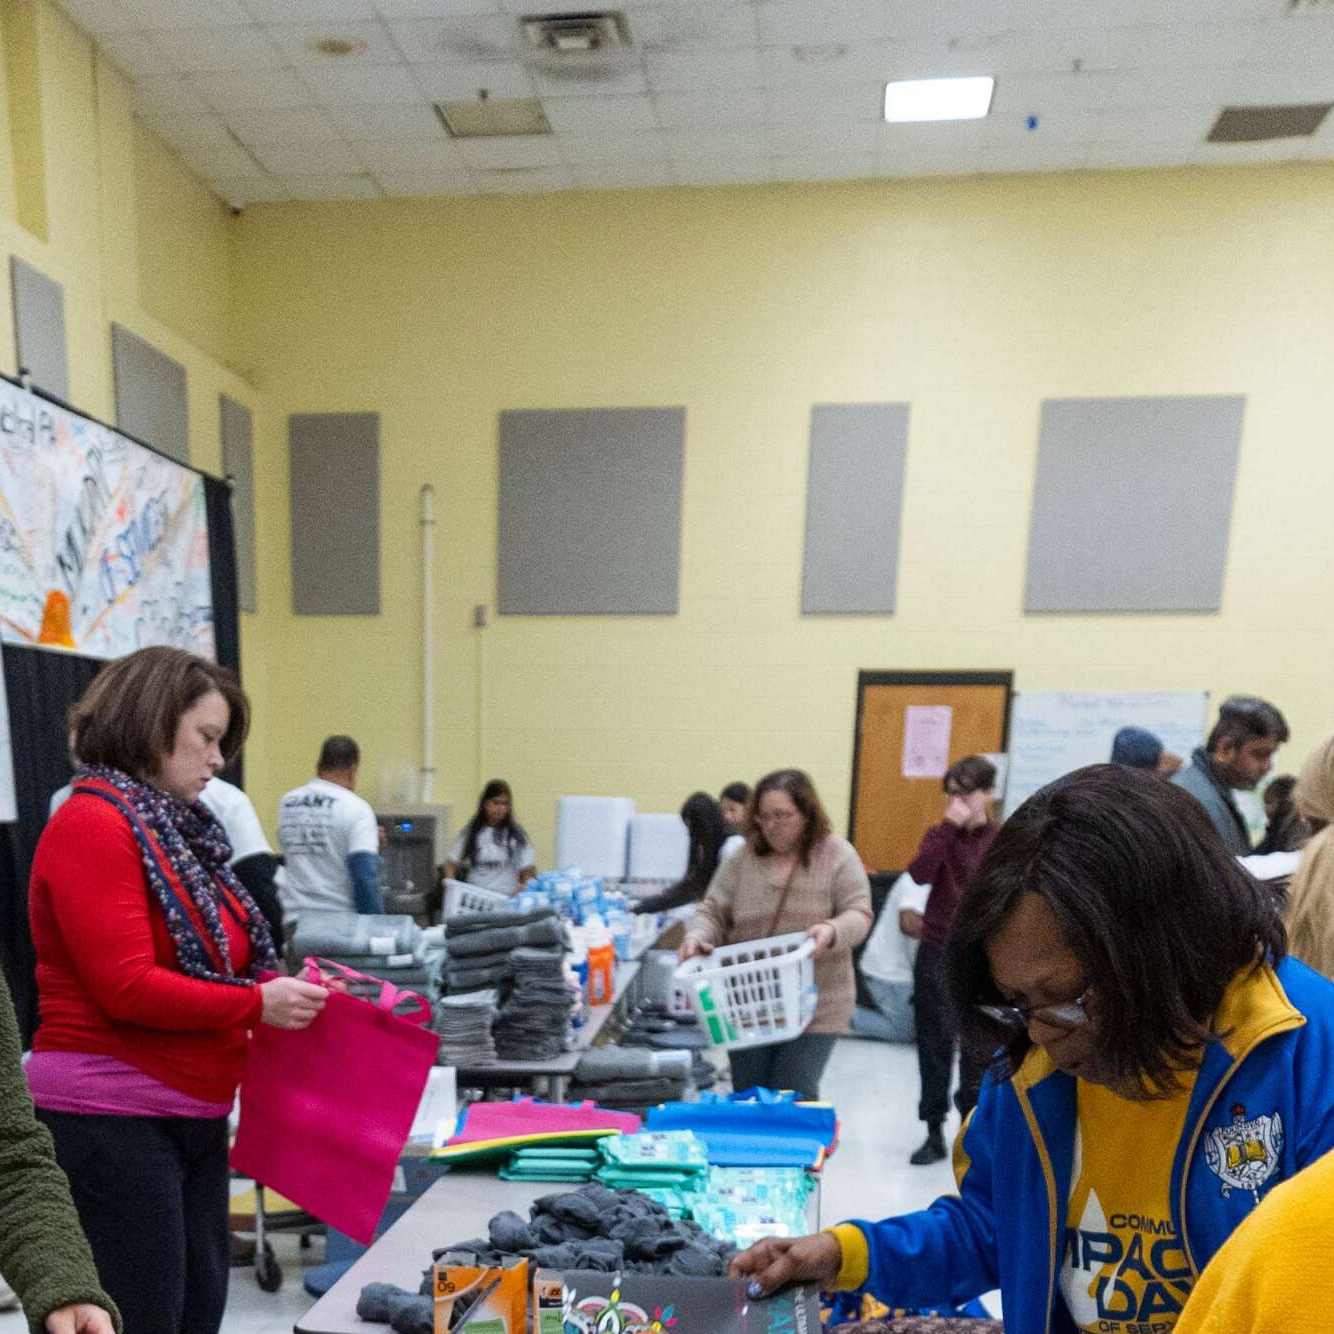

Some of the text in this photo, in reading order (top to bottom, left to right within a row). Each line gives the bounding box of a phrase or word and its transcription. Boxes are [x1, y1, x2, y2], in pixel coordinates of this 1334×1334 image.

[1109, 1213, 1178, 1236] COMMU
[1065, 1226, 1194, 1281] PAC
[1098, 1320, 1121, 1333] OF
